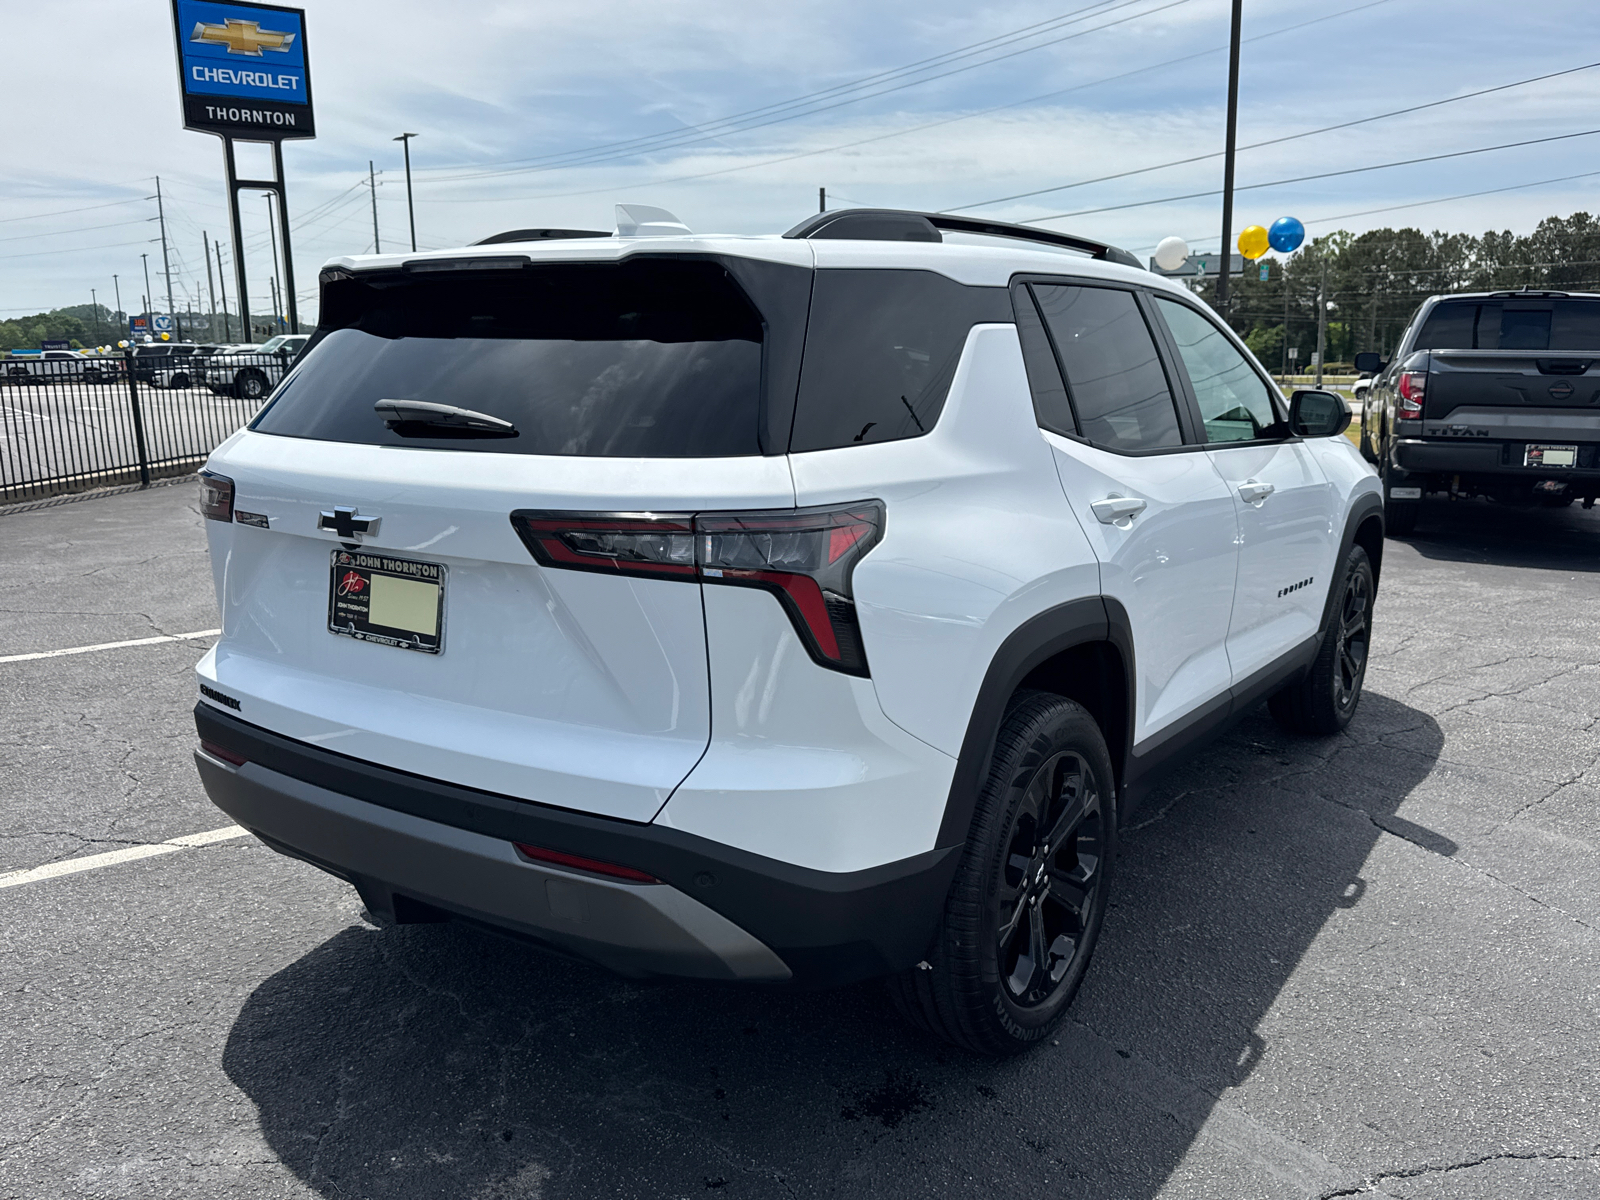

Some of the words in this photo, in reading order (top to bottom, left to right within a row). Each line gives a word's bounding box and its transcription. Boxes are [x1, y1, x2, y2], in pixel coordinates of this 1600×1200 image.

[192, 66, 299, 90] CHEVROLET
[205, 106, 296, 126] THORNTON
[1428, 428, 1489, 437] TITAN
[356, 555, 381, 568] JOHN
[383, 559, 438, 578] THORNTON
[365, 634, 398, 647] CHEVROLET
